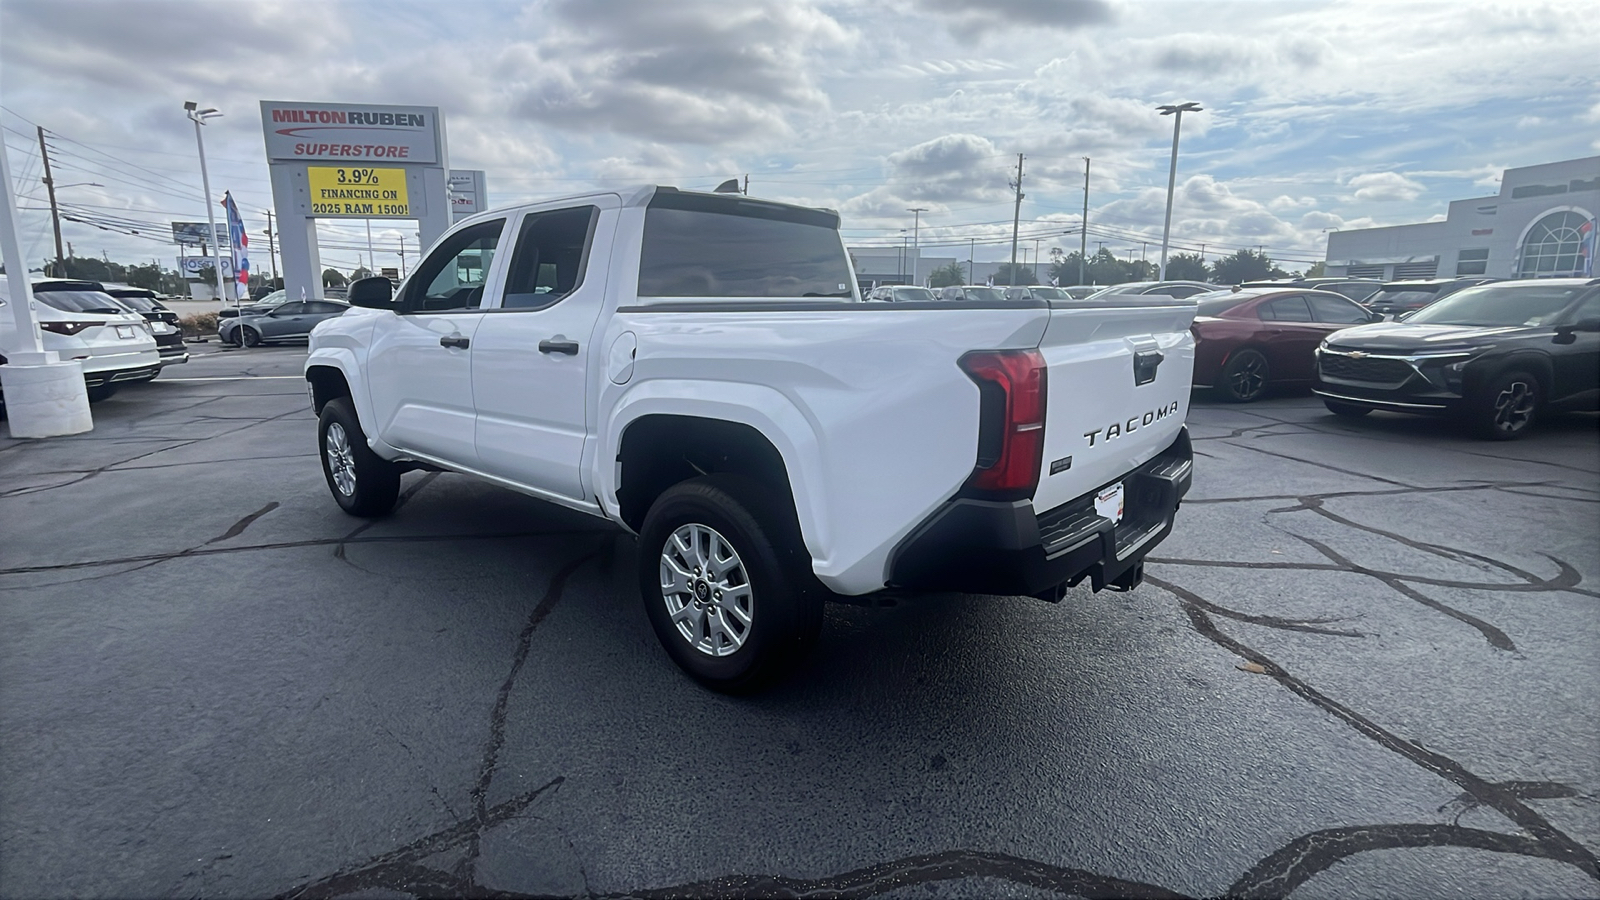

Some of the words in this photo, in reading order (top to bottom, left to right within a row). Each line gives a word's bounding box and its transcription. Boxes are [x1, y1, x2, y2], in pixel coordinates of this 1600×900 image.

[294, 143, 409, 158] SUPERSTORE
[337, 168, 379, 184] 3.9%
[320, 189, 379, 199] FINANCING
[382, 190, 397, 199] ON
[313, 203, 341, 214] 2025
[344, 203, 374, 214] RAM
[377, 204, 409, 215] 1500!
[1083, 401, 1178, 447] TACOMA
